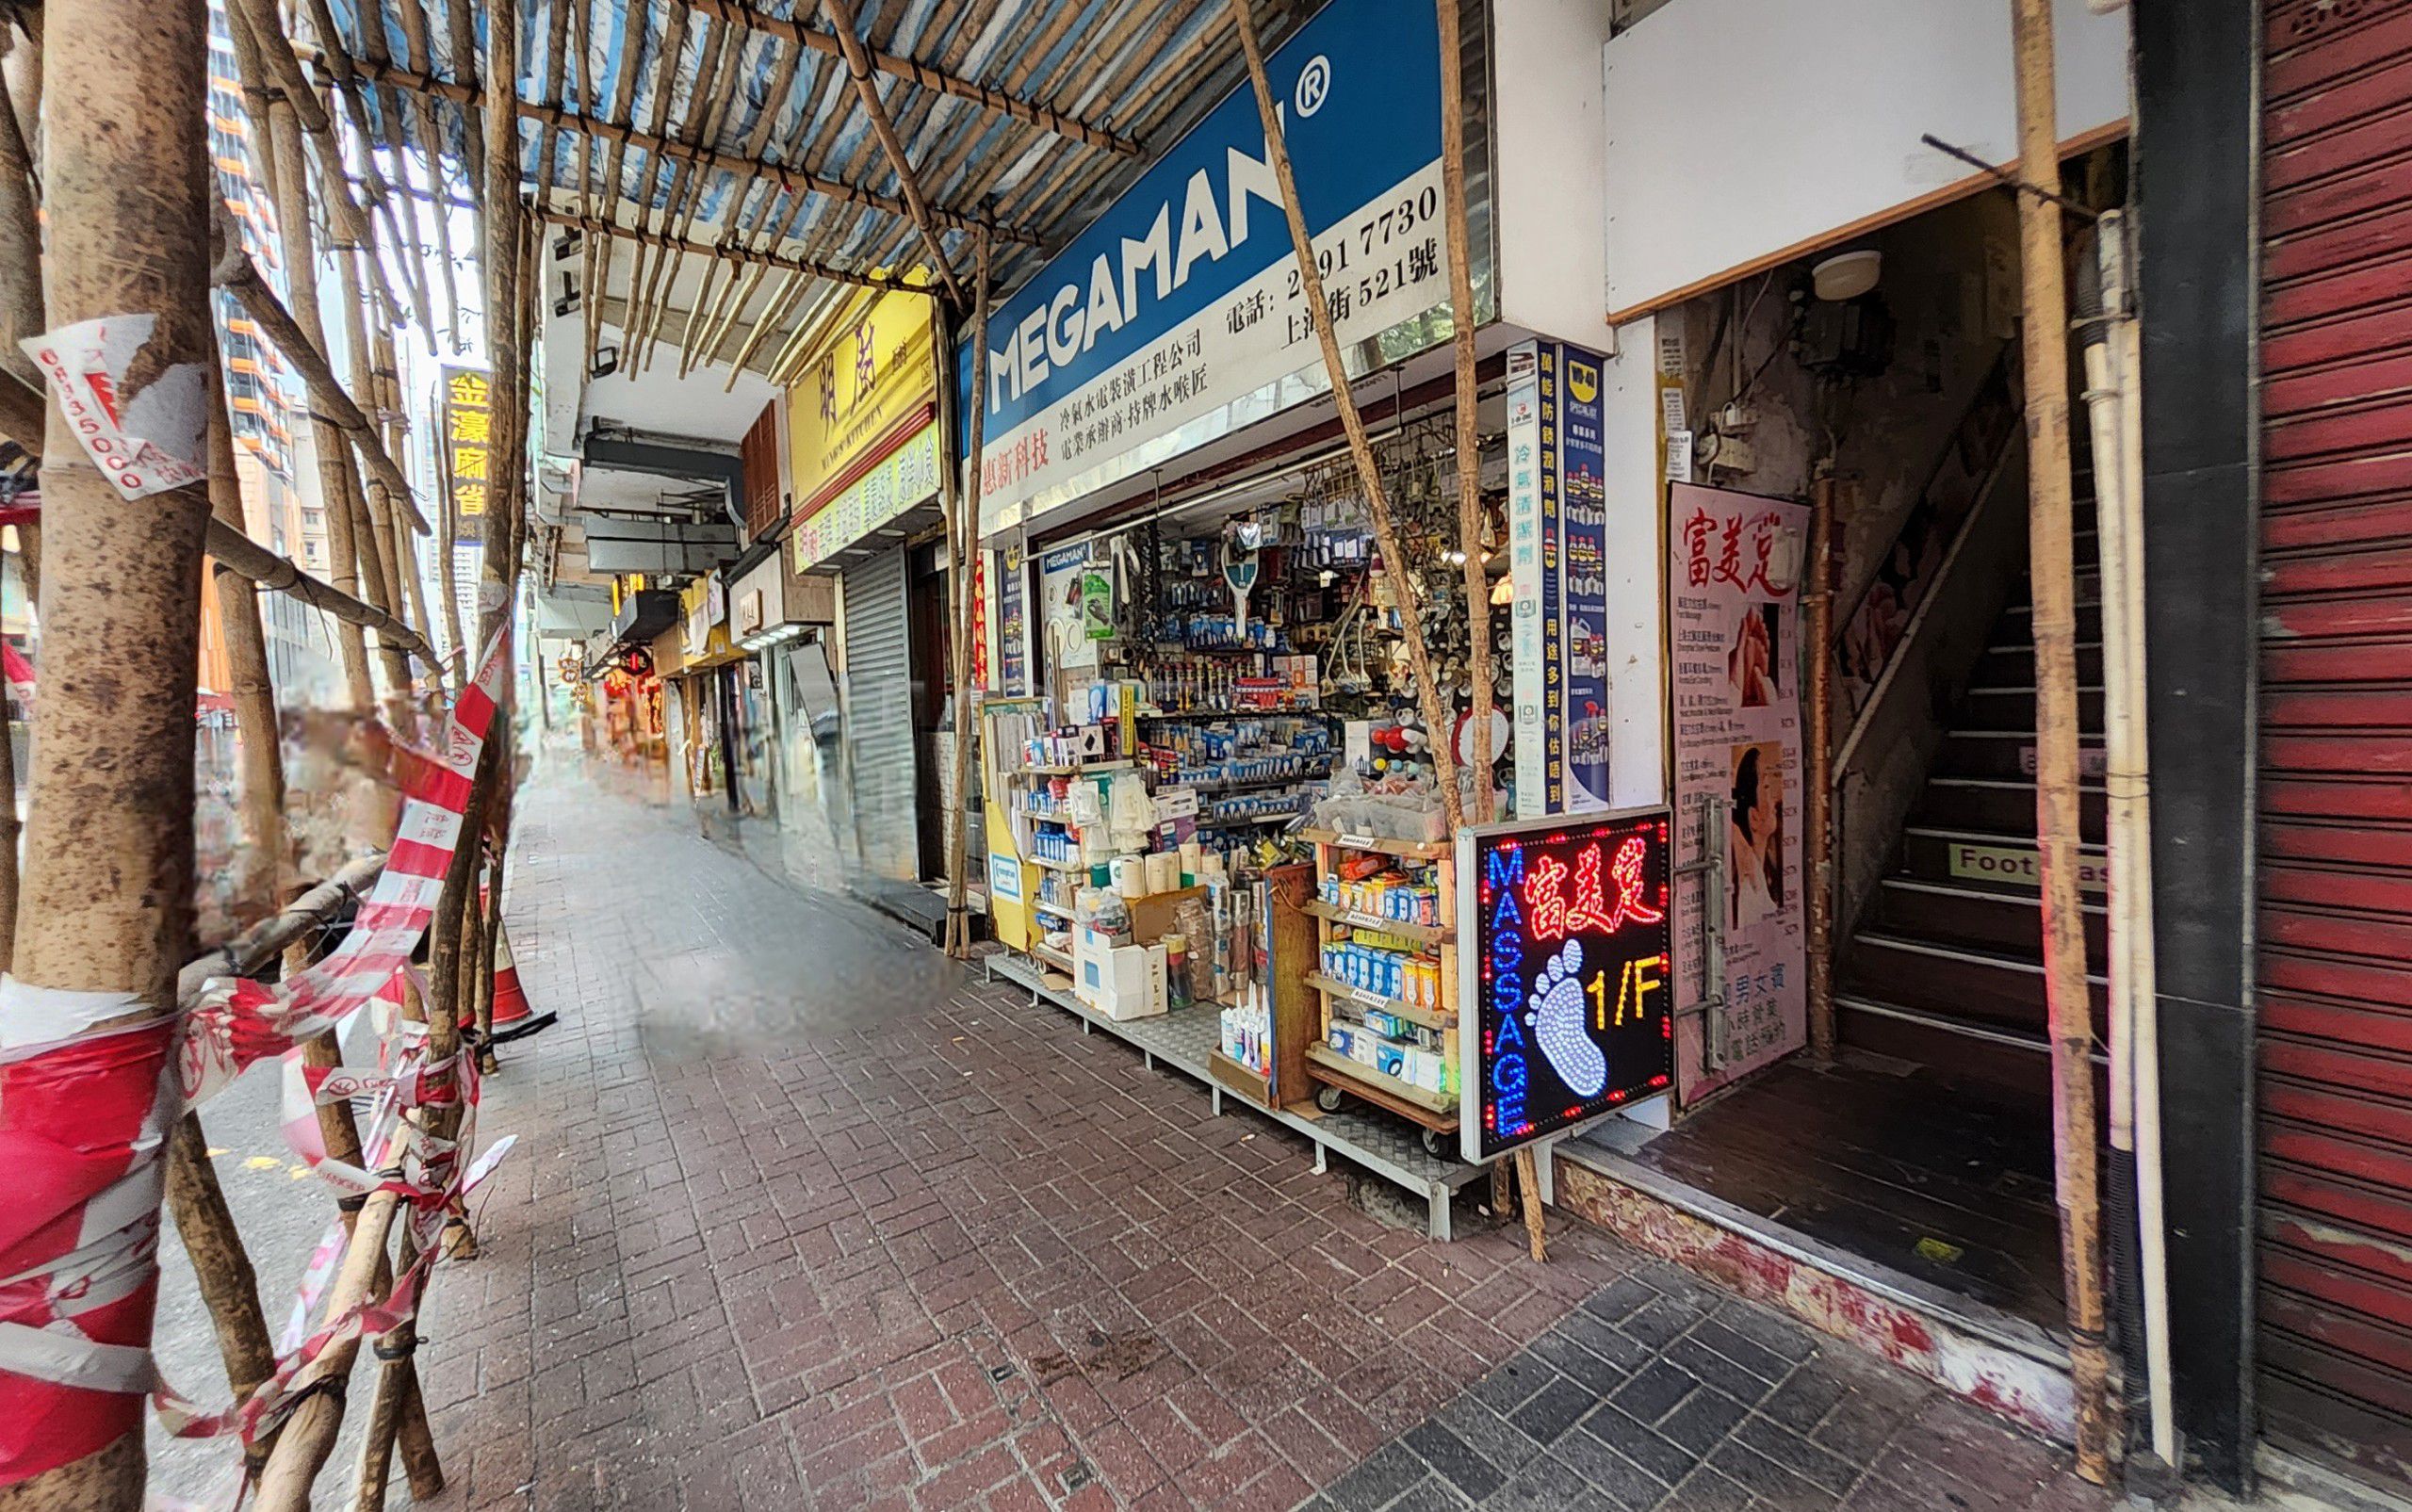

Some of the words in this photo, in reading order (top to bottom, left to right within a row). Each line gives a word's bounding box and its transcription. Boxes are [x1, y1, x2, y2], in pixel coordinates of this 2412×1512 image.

[989, 101, 1287, 416] MEGAMAN
[1287, 237, 1350, 301] 291
[1360, 186, 1437, 256] 7730
[1359, 237, 1439, 308] 521號
[1046, 546, 1084, 568] MEGAMAN
[1960, 848, 2034, 875] Foot
[1488, 847, 1529, 1137] MASSAGE
[1587, 955, 1662, 1031] 1/F
